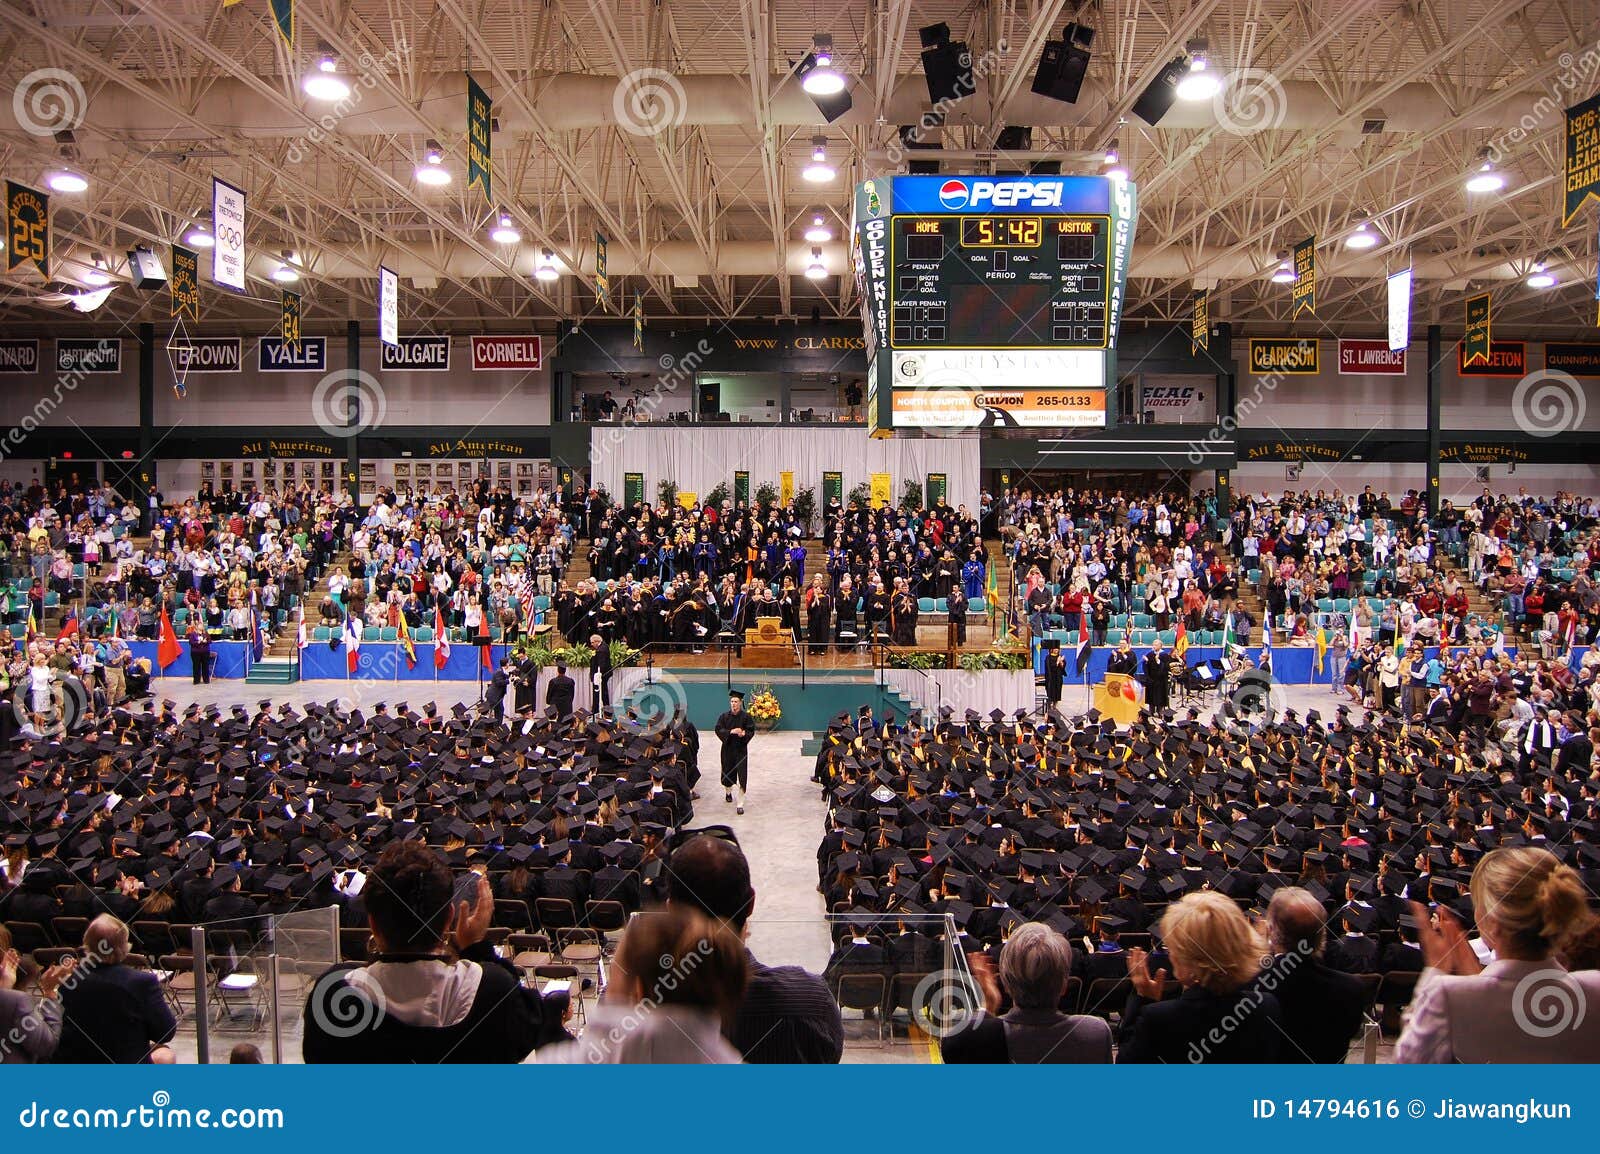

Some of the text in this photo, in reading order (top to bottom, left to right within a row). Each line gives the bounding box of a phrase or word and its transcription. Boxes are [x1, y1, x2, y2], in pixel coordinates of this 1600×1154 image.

[1569, 108, 1600, 136] 1976-
[1576, 126, 1600, 151] ECA
[1567, 164, 1600, 192] CHAM
[970, 182, 1062, 206] PEPSI
[916, 222, 939, 232] HOME
[979, 220, 1038, 243] 5:42
[1058, 222, 1092, 232] VISITOR
[14, 218, 44, 260] 25
[1113, 219, 1129, 284] CHEEL
[866, 220, 887, 347] GOLDEN KNIGHTS
[284, 312, 298, 340] 24
[1108, 286, 1121, 349] ARENA
[60, 348, 117, 363] DARTMOUTH
[179, 346, 237, 365] BROWN
[268, 344, 318, 364] YALE
[385, 343, 446, 364] COLGATE
[476, 342, 538, 362] CORNELL
[1254, 346, 1315, 366] CLARKSON
[1343, 349, 1402, 365] ST. LAWRENCE
[1549, 354, 1600, 365] QUINNIPIA
[1036, 396, 1091, 406] 265-0133
[1144, 388, 1194, 398] ECAC
[242, 440, 332, 454] All American
[430, 442, 450, 455] All
[1248, 444, 1269, 458] All
[1439, 447, 1458, 459] All
